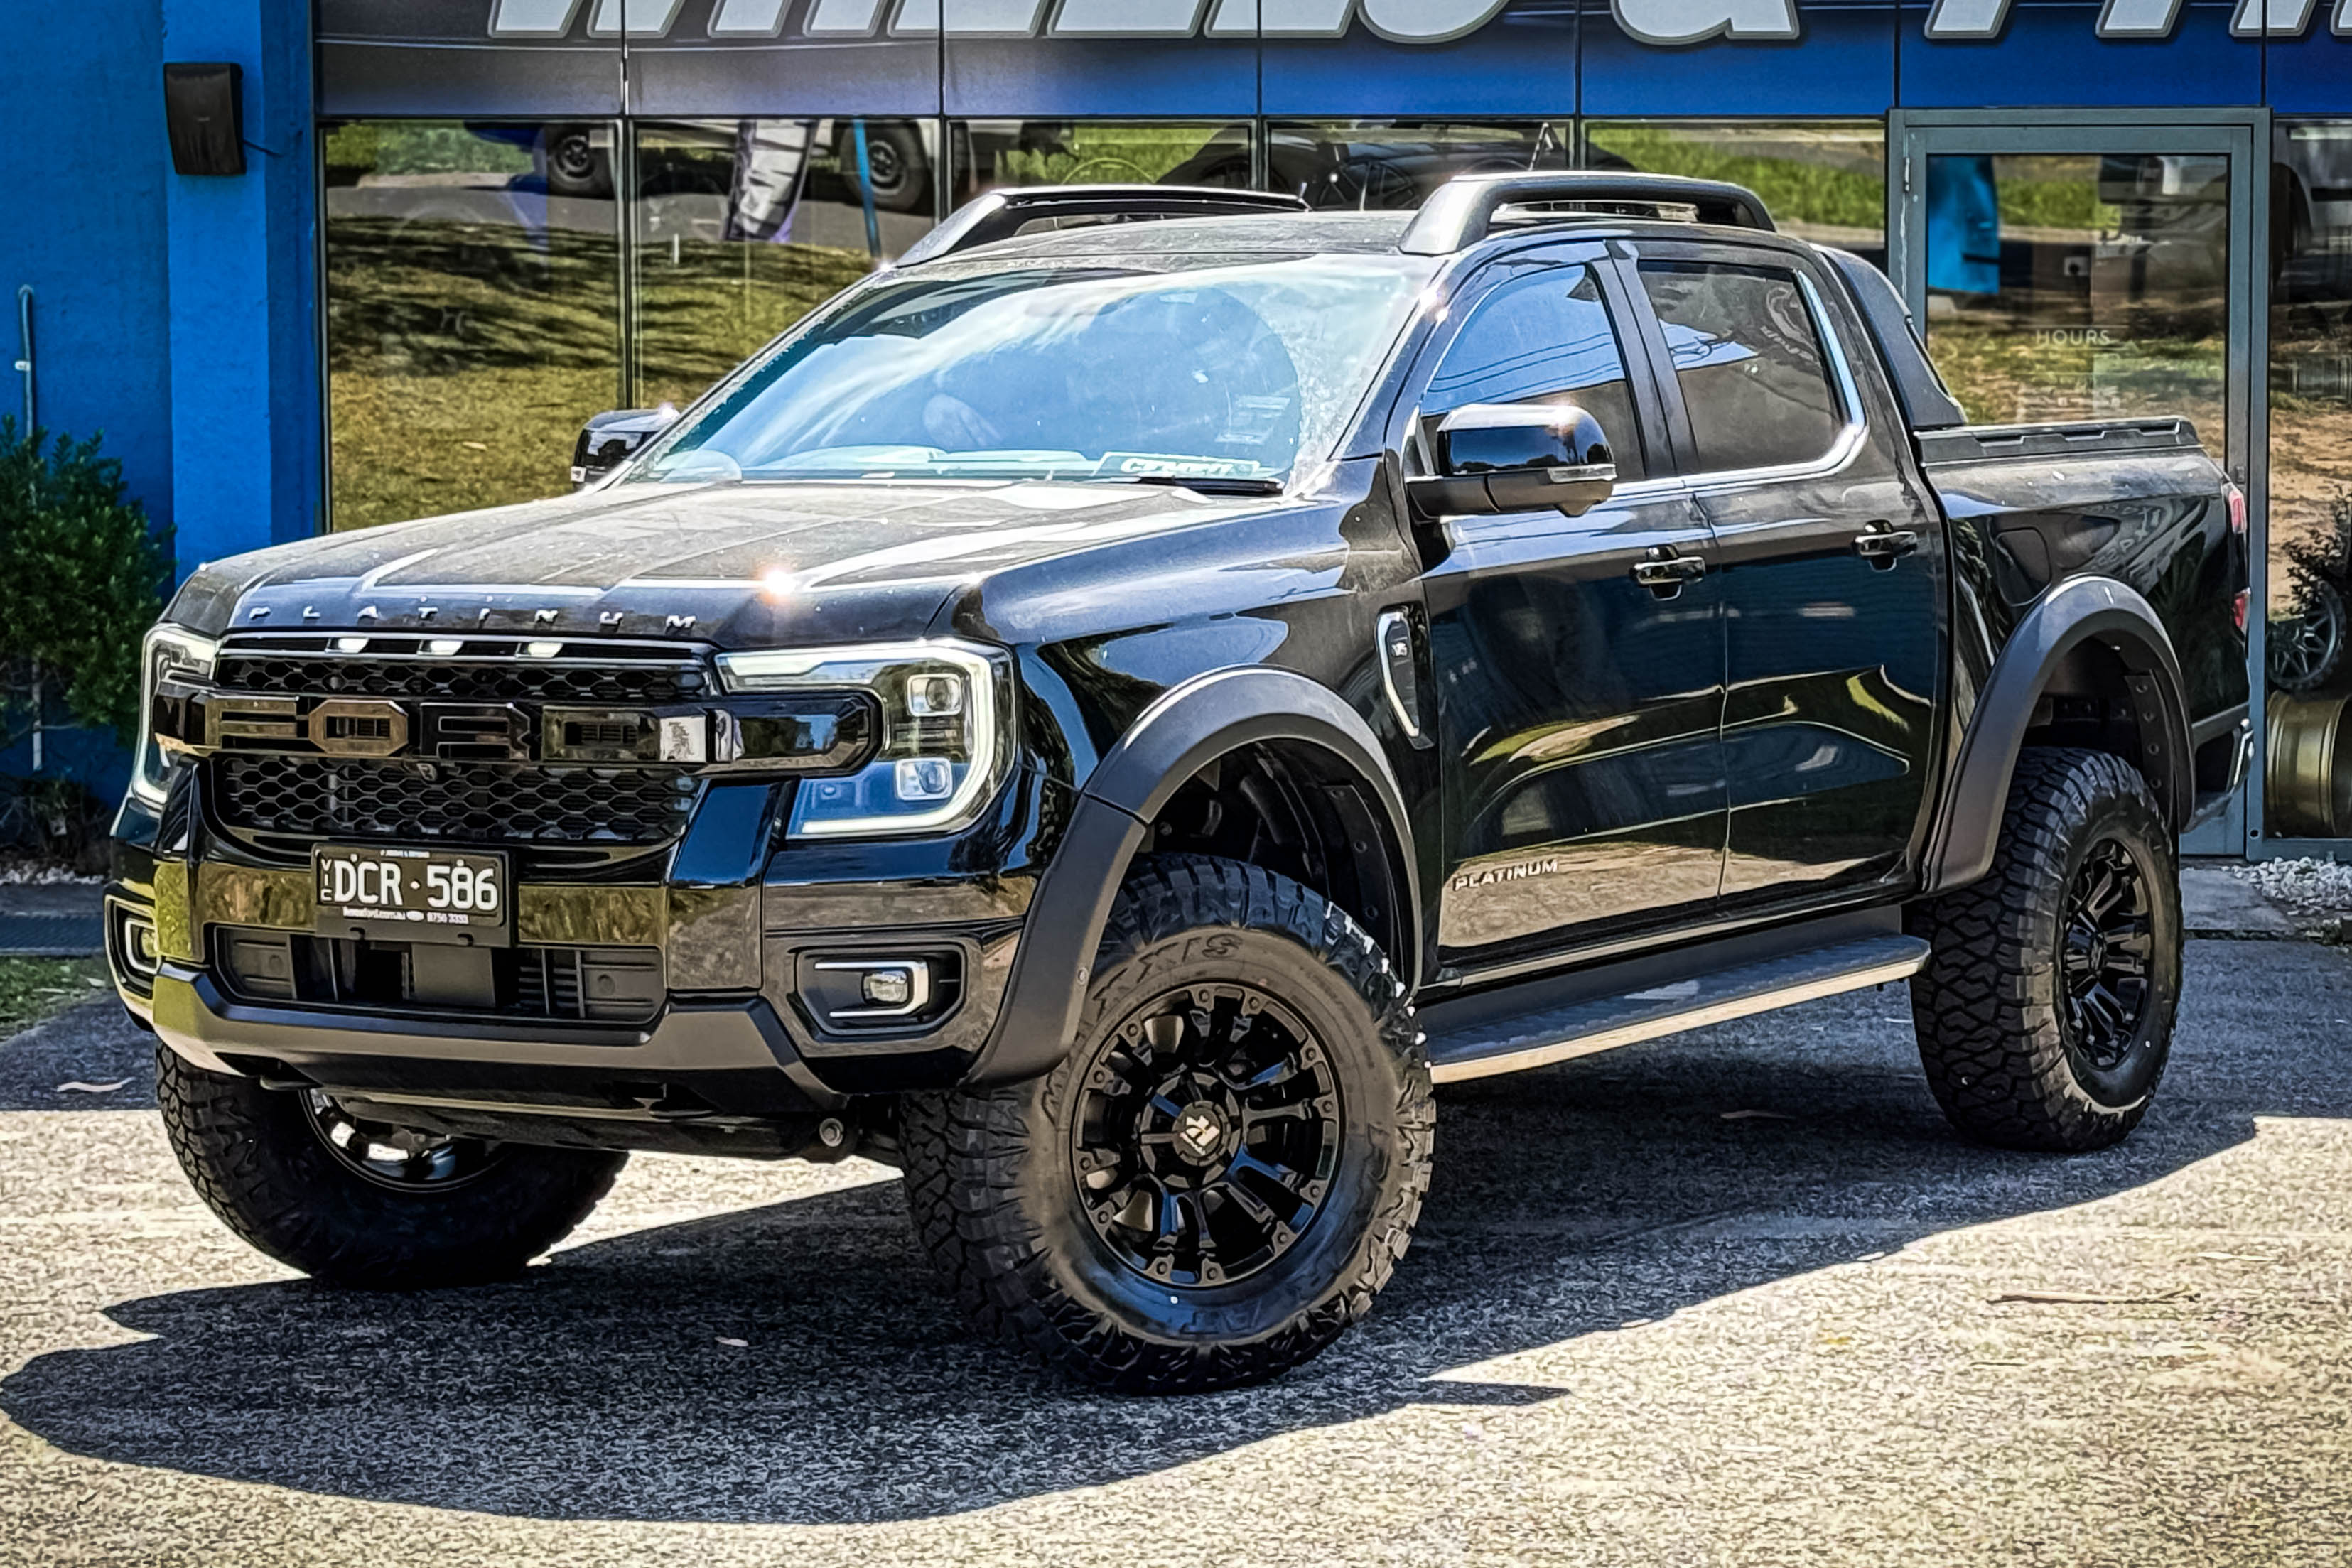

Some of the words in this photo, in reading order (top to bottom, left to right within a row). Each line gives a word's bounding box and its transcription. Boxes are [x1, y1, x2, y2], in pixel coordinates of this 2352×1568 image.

[2036, 329, 2111, 345] HOURS
[248, 605, 697, 629] PLATINUM
[204, 695, 659, 763] FORD
[321, 858, 333, 902] VIC
[333, 860, 404, 907] DCR
[426, 865, 498, 912] 586
[1452, 858, 1559, 892] PLATINUM
